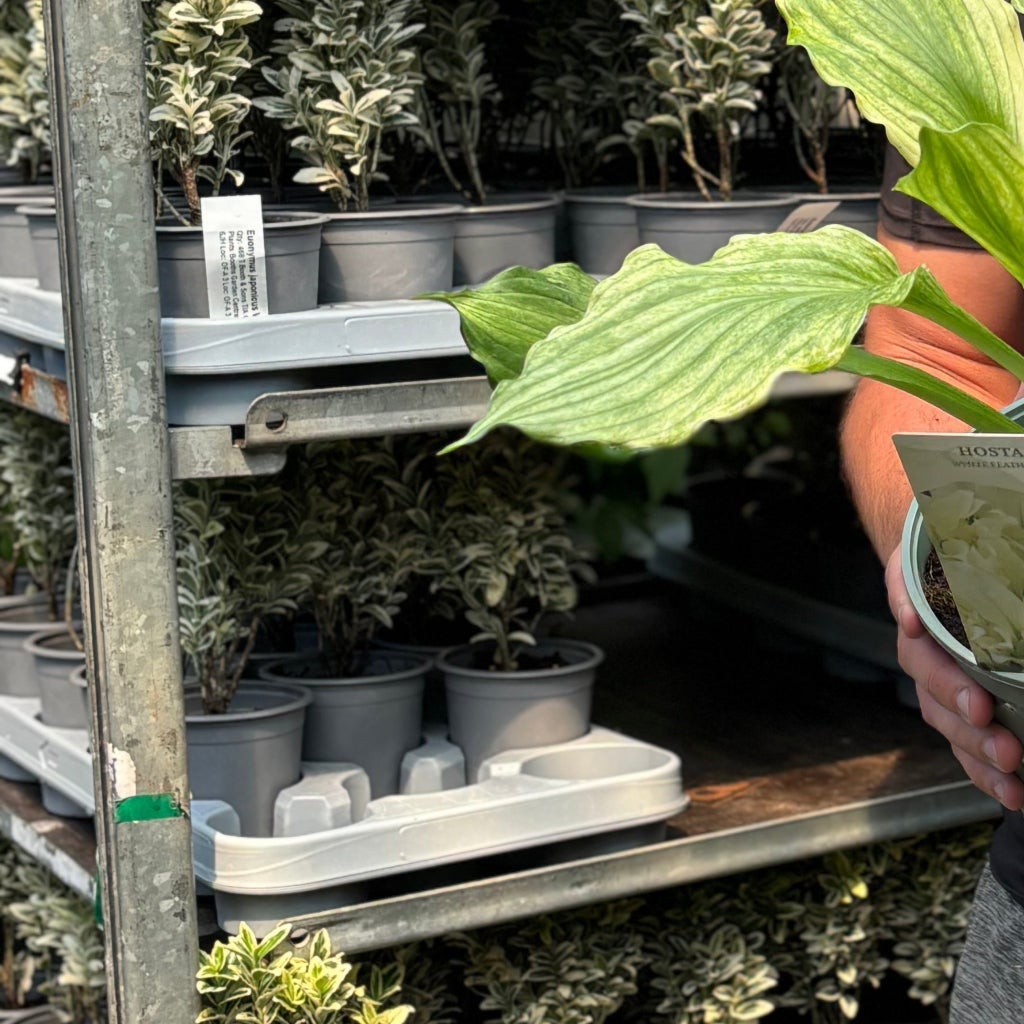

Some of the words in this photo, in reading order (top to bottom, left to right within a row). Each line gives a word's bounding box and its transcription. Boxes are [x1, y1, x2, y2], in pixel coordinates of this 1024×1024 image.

[246, 229, 256, 273] Euonymus
[248, 274, 259, 311] japonicus
[958, 446, 1024, 458] HOSTA
